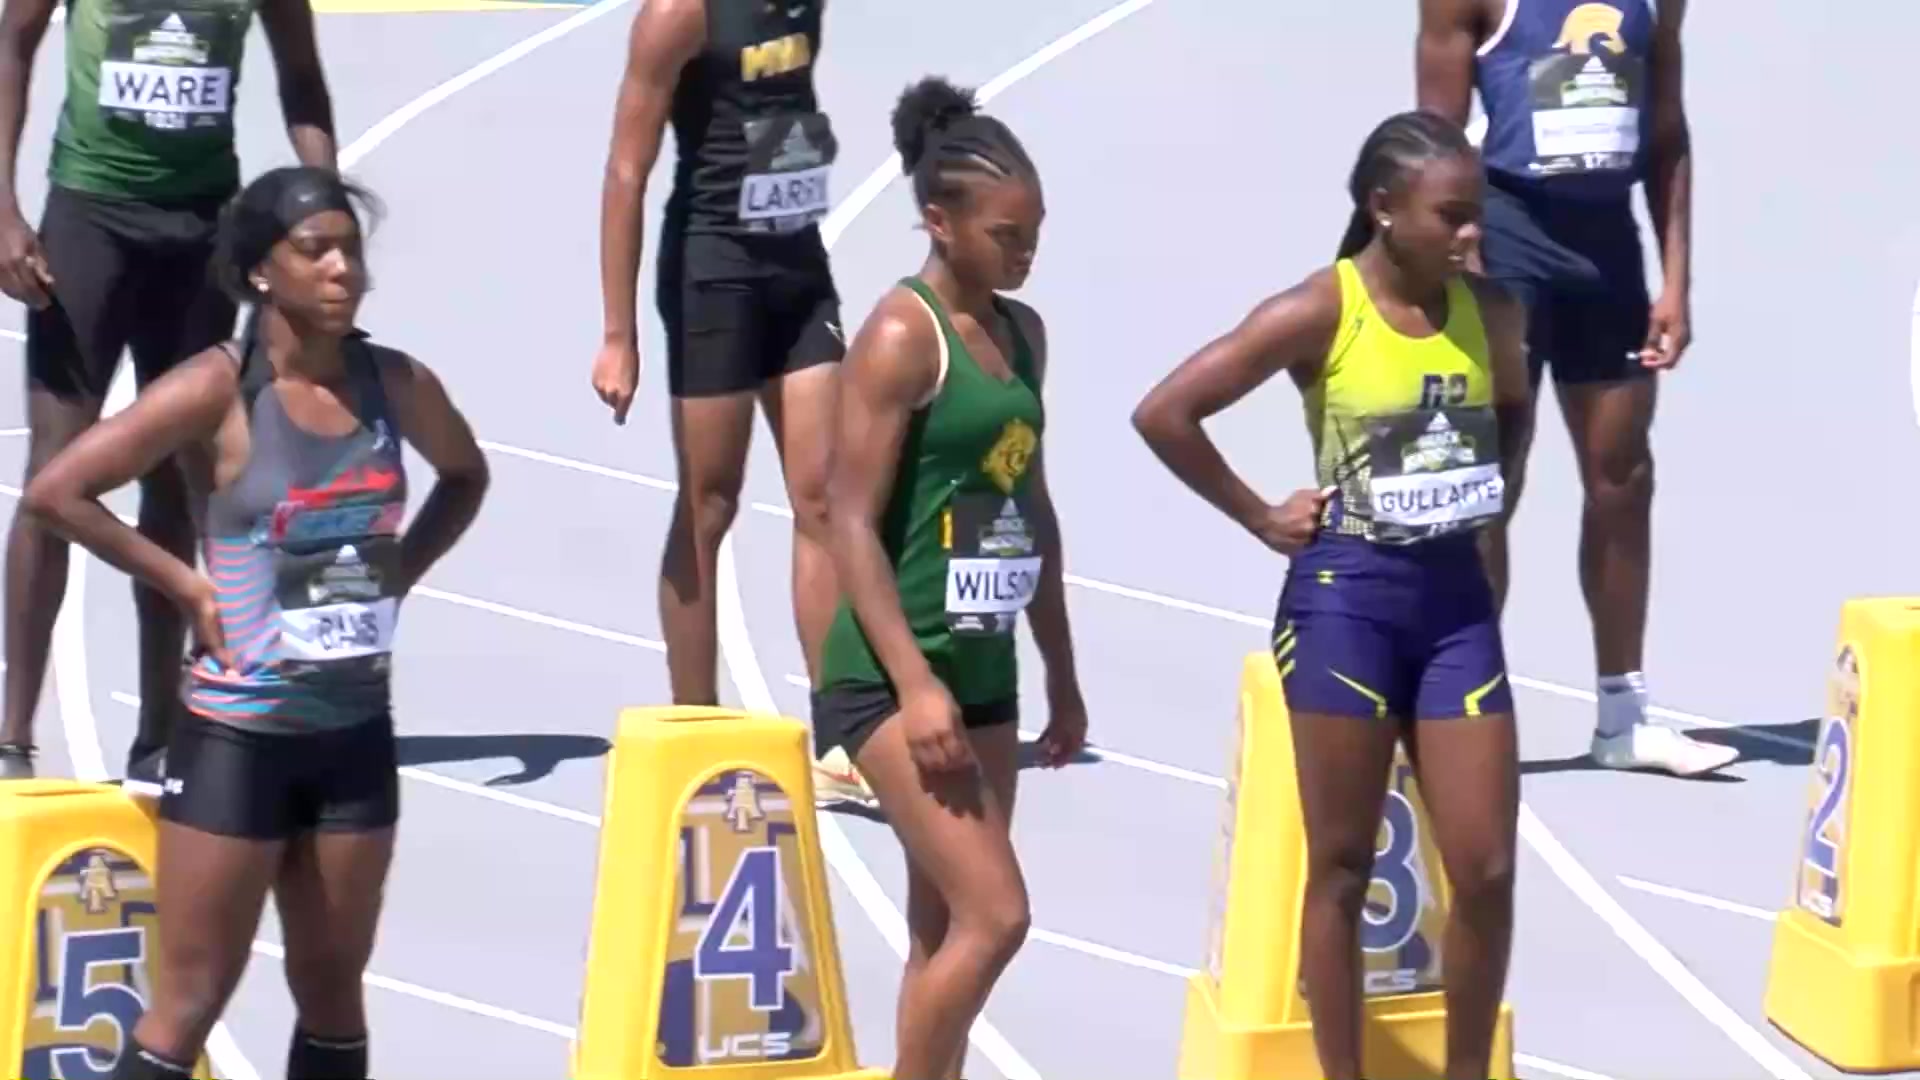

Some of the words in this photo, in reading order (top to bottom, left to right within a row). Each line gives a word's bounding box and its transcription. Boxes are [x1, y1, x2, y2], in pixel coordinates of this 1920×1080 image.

[114, 71, 221, 106] WARE
[955, 570, 1037, 601] WILSO
[1808, 715, 1846, 877] 2
[694, 846, 794, 1010] 4
[1363, 968, 1416, 993] CS
[50, 927, 147, 1079] 5
[698, 1032, 792, 1058] UCS
